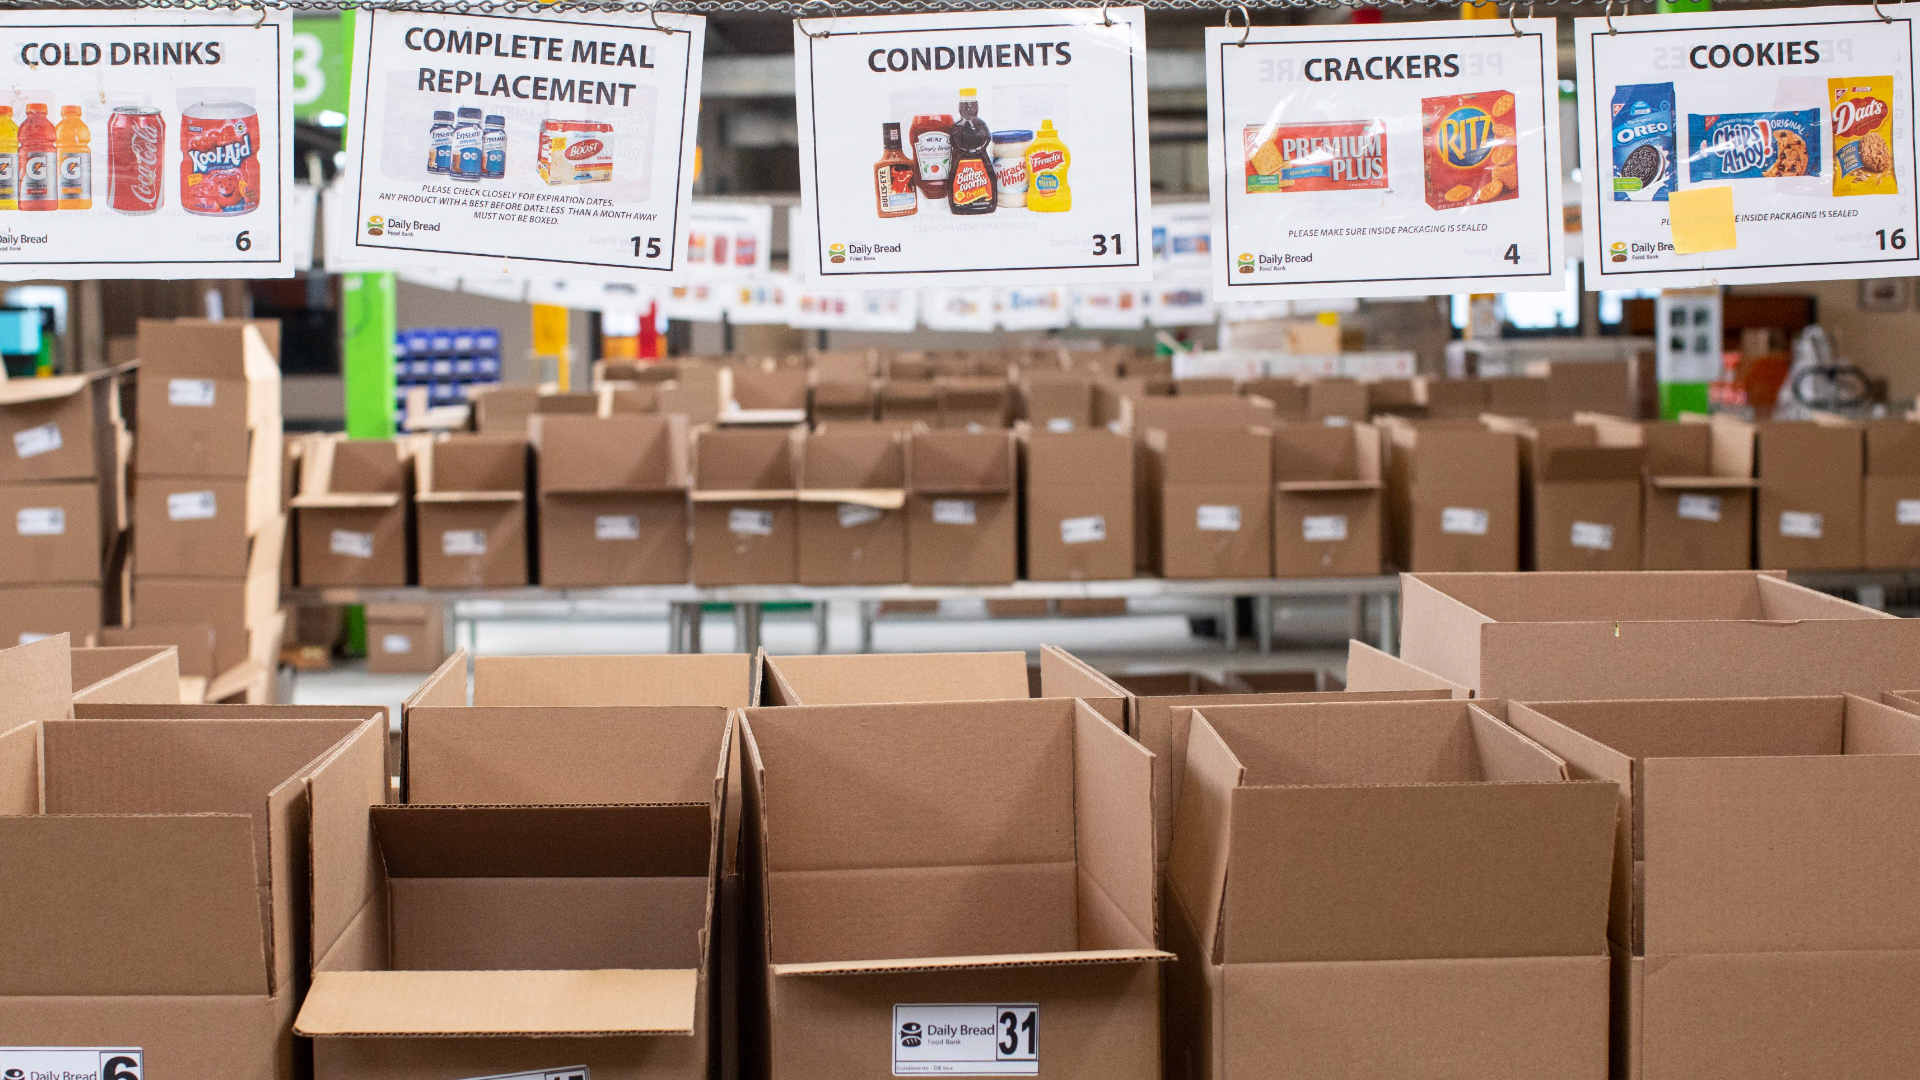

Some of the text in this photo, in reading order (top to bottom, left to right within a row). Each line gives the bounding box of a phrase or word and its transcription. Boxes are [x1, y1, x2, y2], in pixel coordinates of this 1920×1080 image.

[20, 41, 221, 67] COLD DRINKS
[404, 26, 655, 70] COMPLETE MEAL
[867, 41, 1072, 73] CONDIMENTS
[1689, 40, 1820, 70] COOKIES
[1304, 53, 1460, 83] CRACKERS
[417, 67, 637, 108] REPLACEMENT
[1771, 119, 1806, 135] ORIGINAL
[1832, 99, 1883, 136] Dad's
[456, 131, 480, 140] Ensure
[1440, 115, 1491, 164] RITZ
[1616, 122, 1668, 143] OREO
[1713, 124, 1762, 156] Chips
[189, 135, 251, 173] Kool-Aid
[570, 142, 598, 157] BOOST
[1282, 134, 1382, 161] PREMIUM
[26, 157, 47, 180] G
[61, 157, 81, 180] G
[131, 120, 158, 204] Coca-Cola
[1033, 153, 1061, 167] French's
[1332, 157, 1384, 181] PLUS
[1002, 172, 1025, 187] Whip
[379, 192, 657, 222] ANY PRODUCT WITH A BEST BEFORE DATE LESS THAN A MONTH AWAY
[421, 185, 614, 207] PLEASE CHECK CLOSELY FOR EXPIRATION DATES.
[388, 218, 441, 232] Daily Bread
[473, 211, 559, 225] MUST NOT BE BOXED.
[1741, 213, 1768, 222] INSIDE
[1769, 211, 1817, 221] PACKAGING
[1828, 209, 1859, 218] SEALED
[20, 234, 48, 244] Bread
[235, 230, 252, 252] 6
[1288, 223, 1488, 238] PLEASE MAKE SURE INSIDE PACKAGING IS SEALED
[1875, 228, 1907, 251] 16
[630, 235, 662, 259] 15
[849, 243, 901, 255] Daily Bread
[1092, 233, 1123, 256] 31
[1503, 243, 1521, 265] 4
[1631, 242, 1675, 254] Daily Bre
[1258, 253, 1313, 265] Daily Bread
[927, 1011, 1037, 1055] Daily Bread 31
[30, 1071, 60, 1080] Daily
[63, 1071, 97, 1080] Bread
